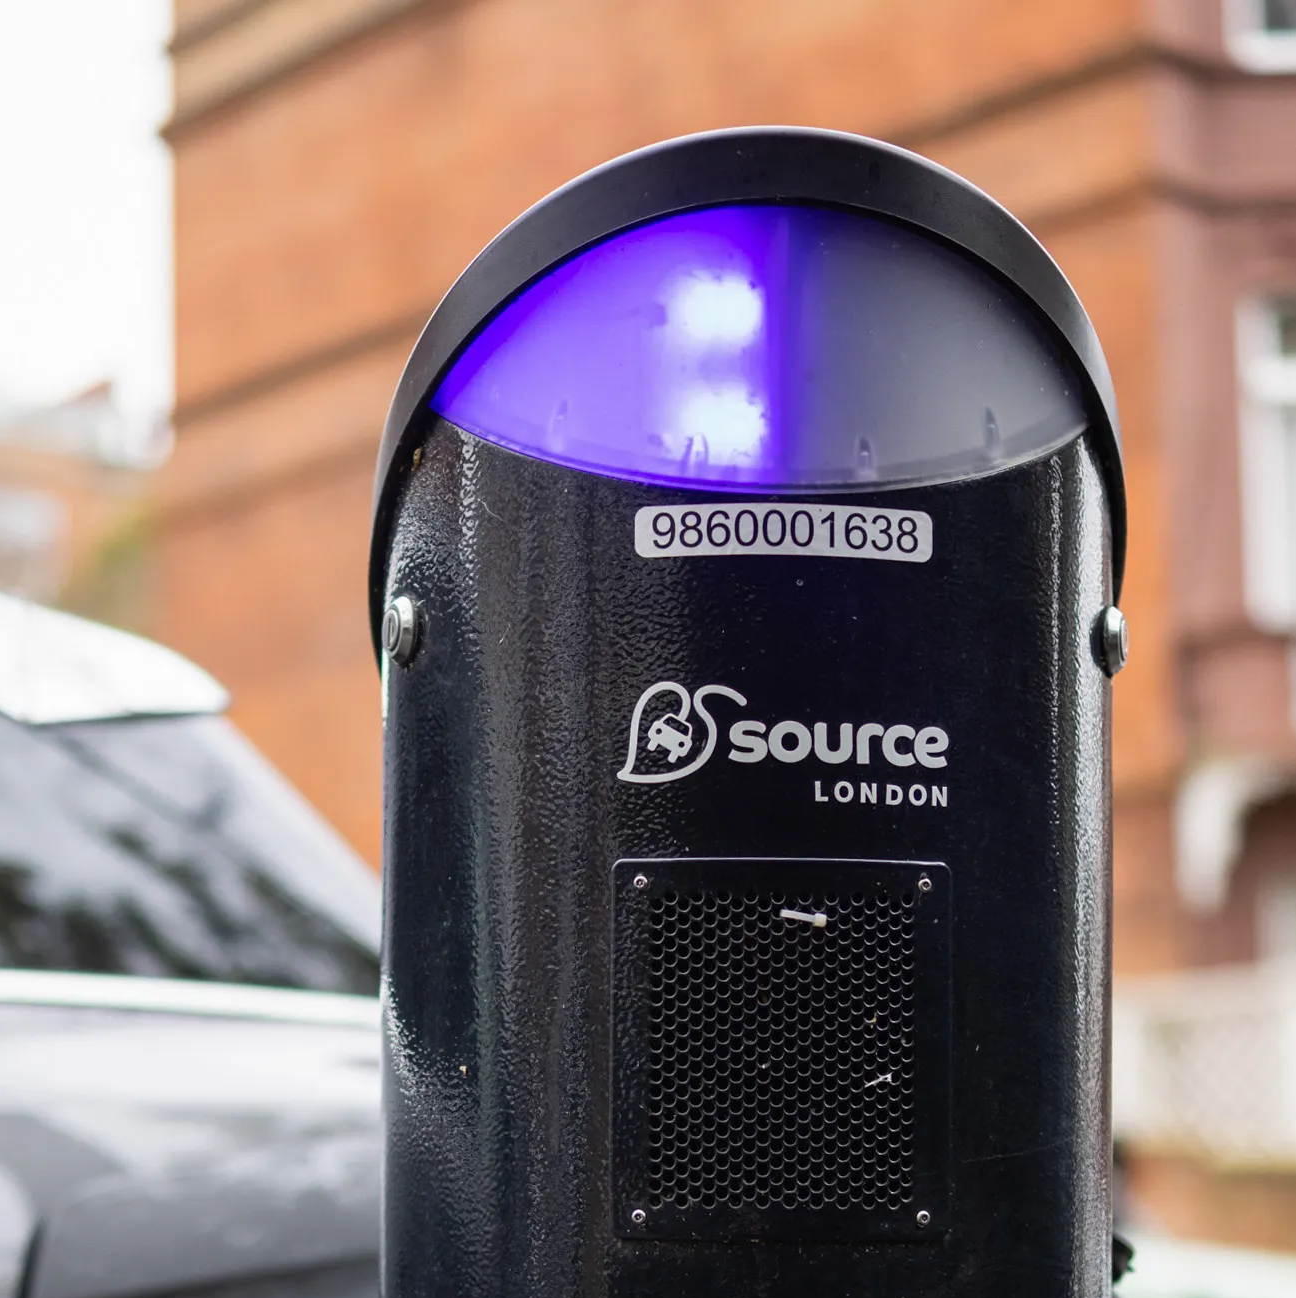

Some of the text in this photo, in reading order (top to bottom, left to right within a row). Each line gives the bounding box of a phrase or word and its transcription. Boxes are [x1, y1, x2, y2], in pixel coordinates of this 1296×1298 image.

[652, 509, 919, 553] 9860001638
[728, 720, 949, 769] source
[814, 780, 948, 807] LONDON
